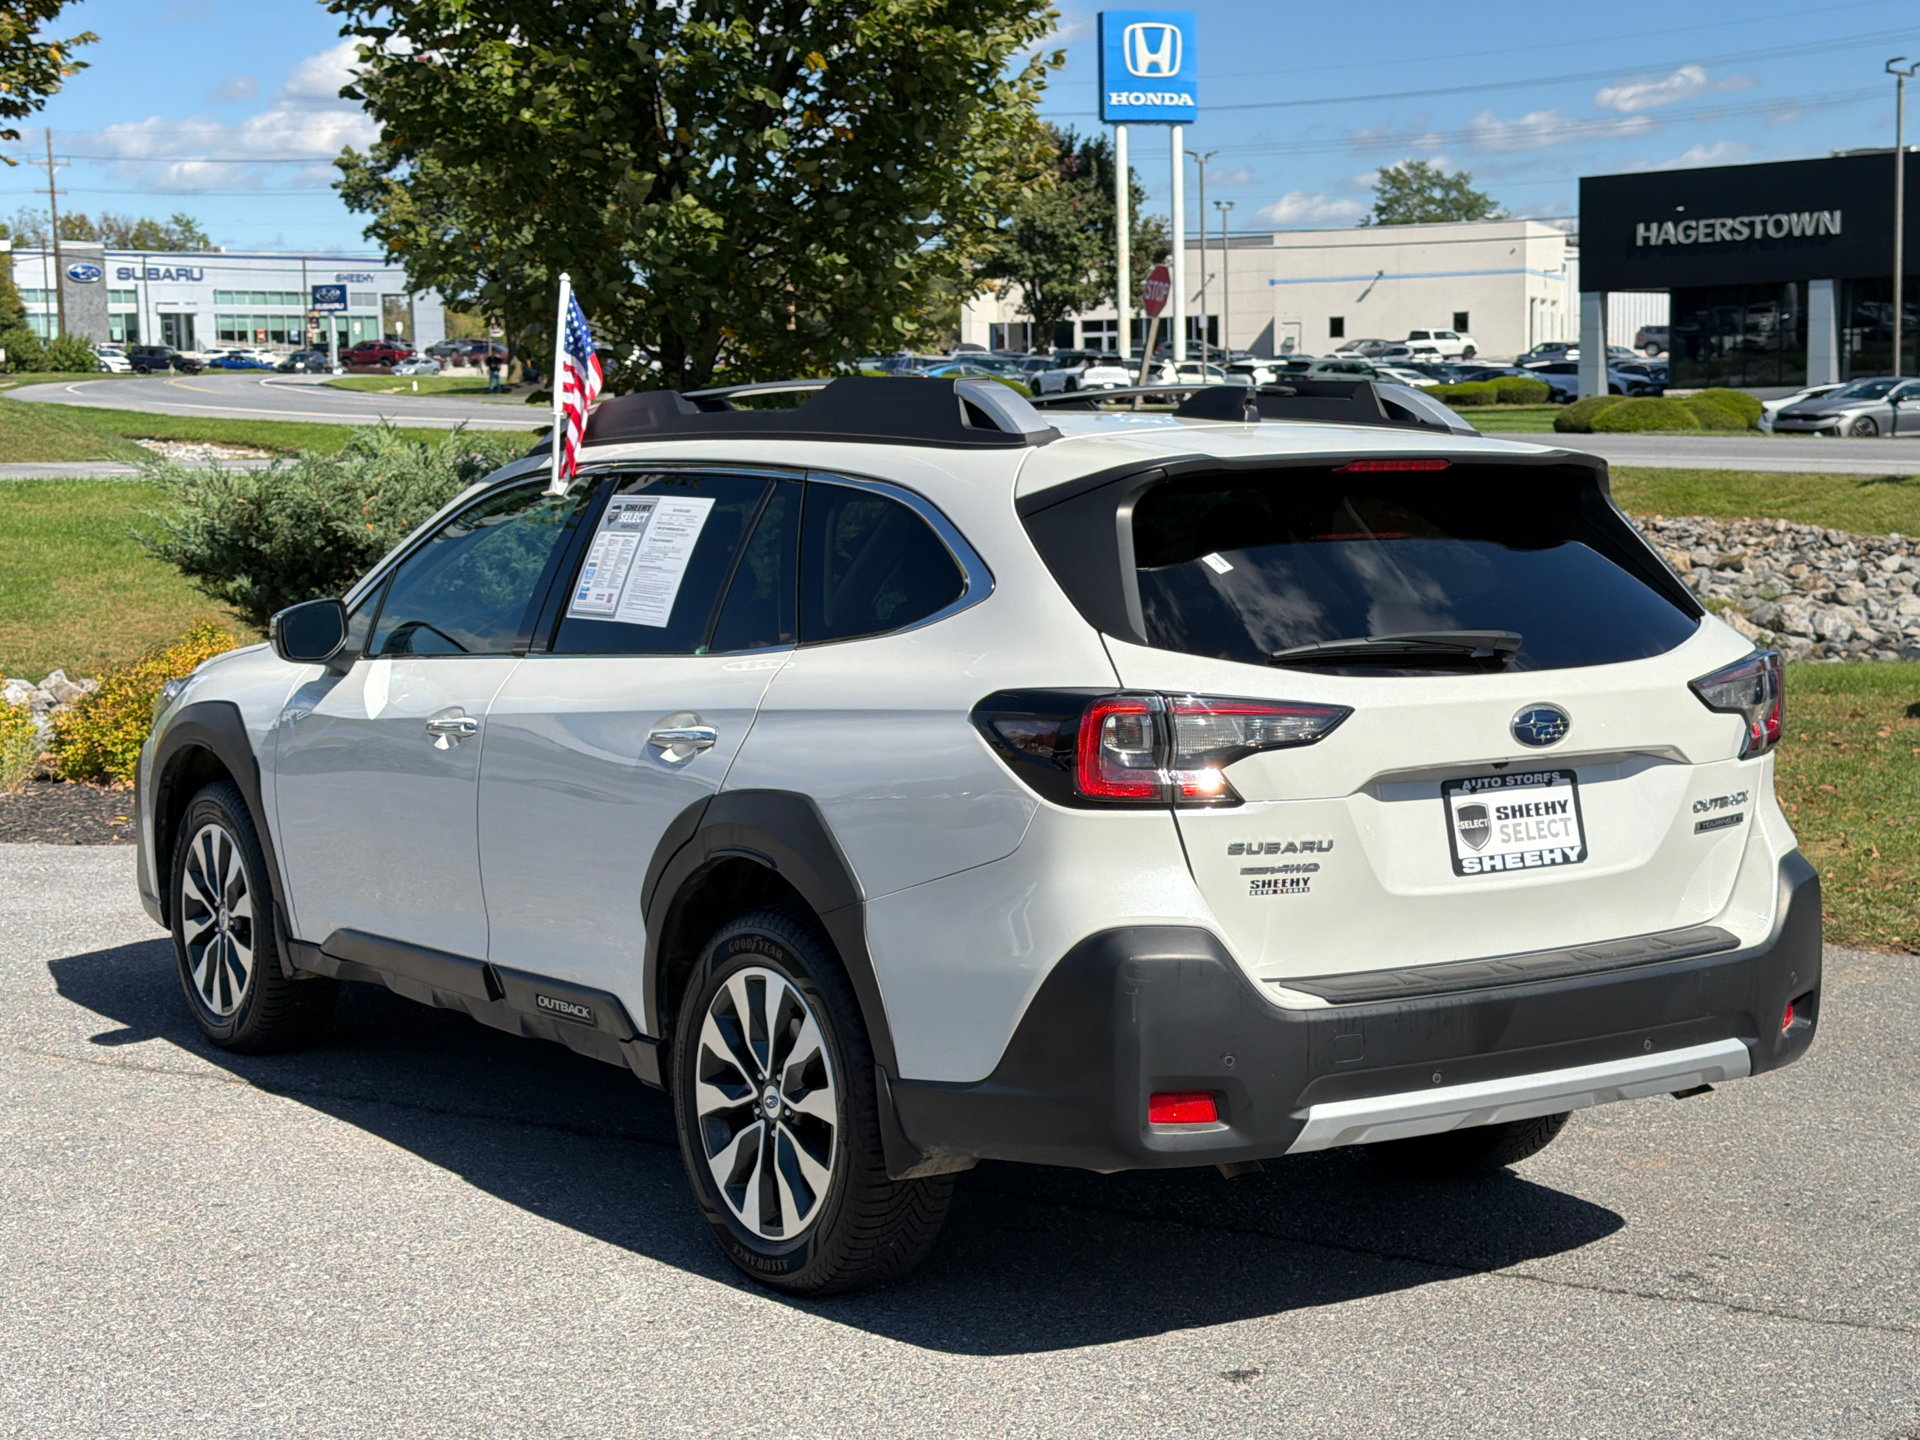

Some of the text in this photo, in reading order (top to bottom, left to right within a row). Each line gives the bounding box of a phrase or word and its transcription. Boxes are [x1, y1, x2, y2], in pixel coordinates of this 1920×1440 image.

[1109, 92, 1195, 106] HONDA
[1635, 209, 1843, 247] HAGERSTOWN
[116, 267, 204, 281] SUBARU
[335, 273, 375, 283] SHEEHY
[1144, 281, 1170, 302] STOP
[618, 512, 650, 523] SELECT
[1462, 772, 1561, 790] AUTO STORES
[1495, 799, 1569, 821] SHEEHY
[1692, 789, 1749, 814] OUTBACK
[1459, 819, 1490, 829] SELECT
[1500, 817, 1572, 844] SELECT
[1227, 840, 1334, 856] SUBARU
[1462, 845, 1582, 874] SHEEHY
[1249, 877, 1311, 889] SHEEHY
[1250, 888, 1274, 896] AUTO
[728, 936, 783, 960] GOODYEAR
[537, 996, 590, 1019] OUTBACK
[732, 1243, 789, 1271] ASSURANCE
